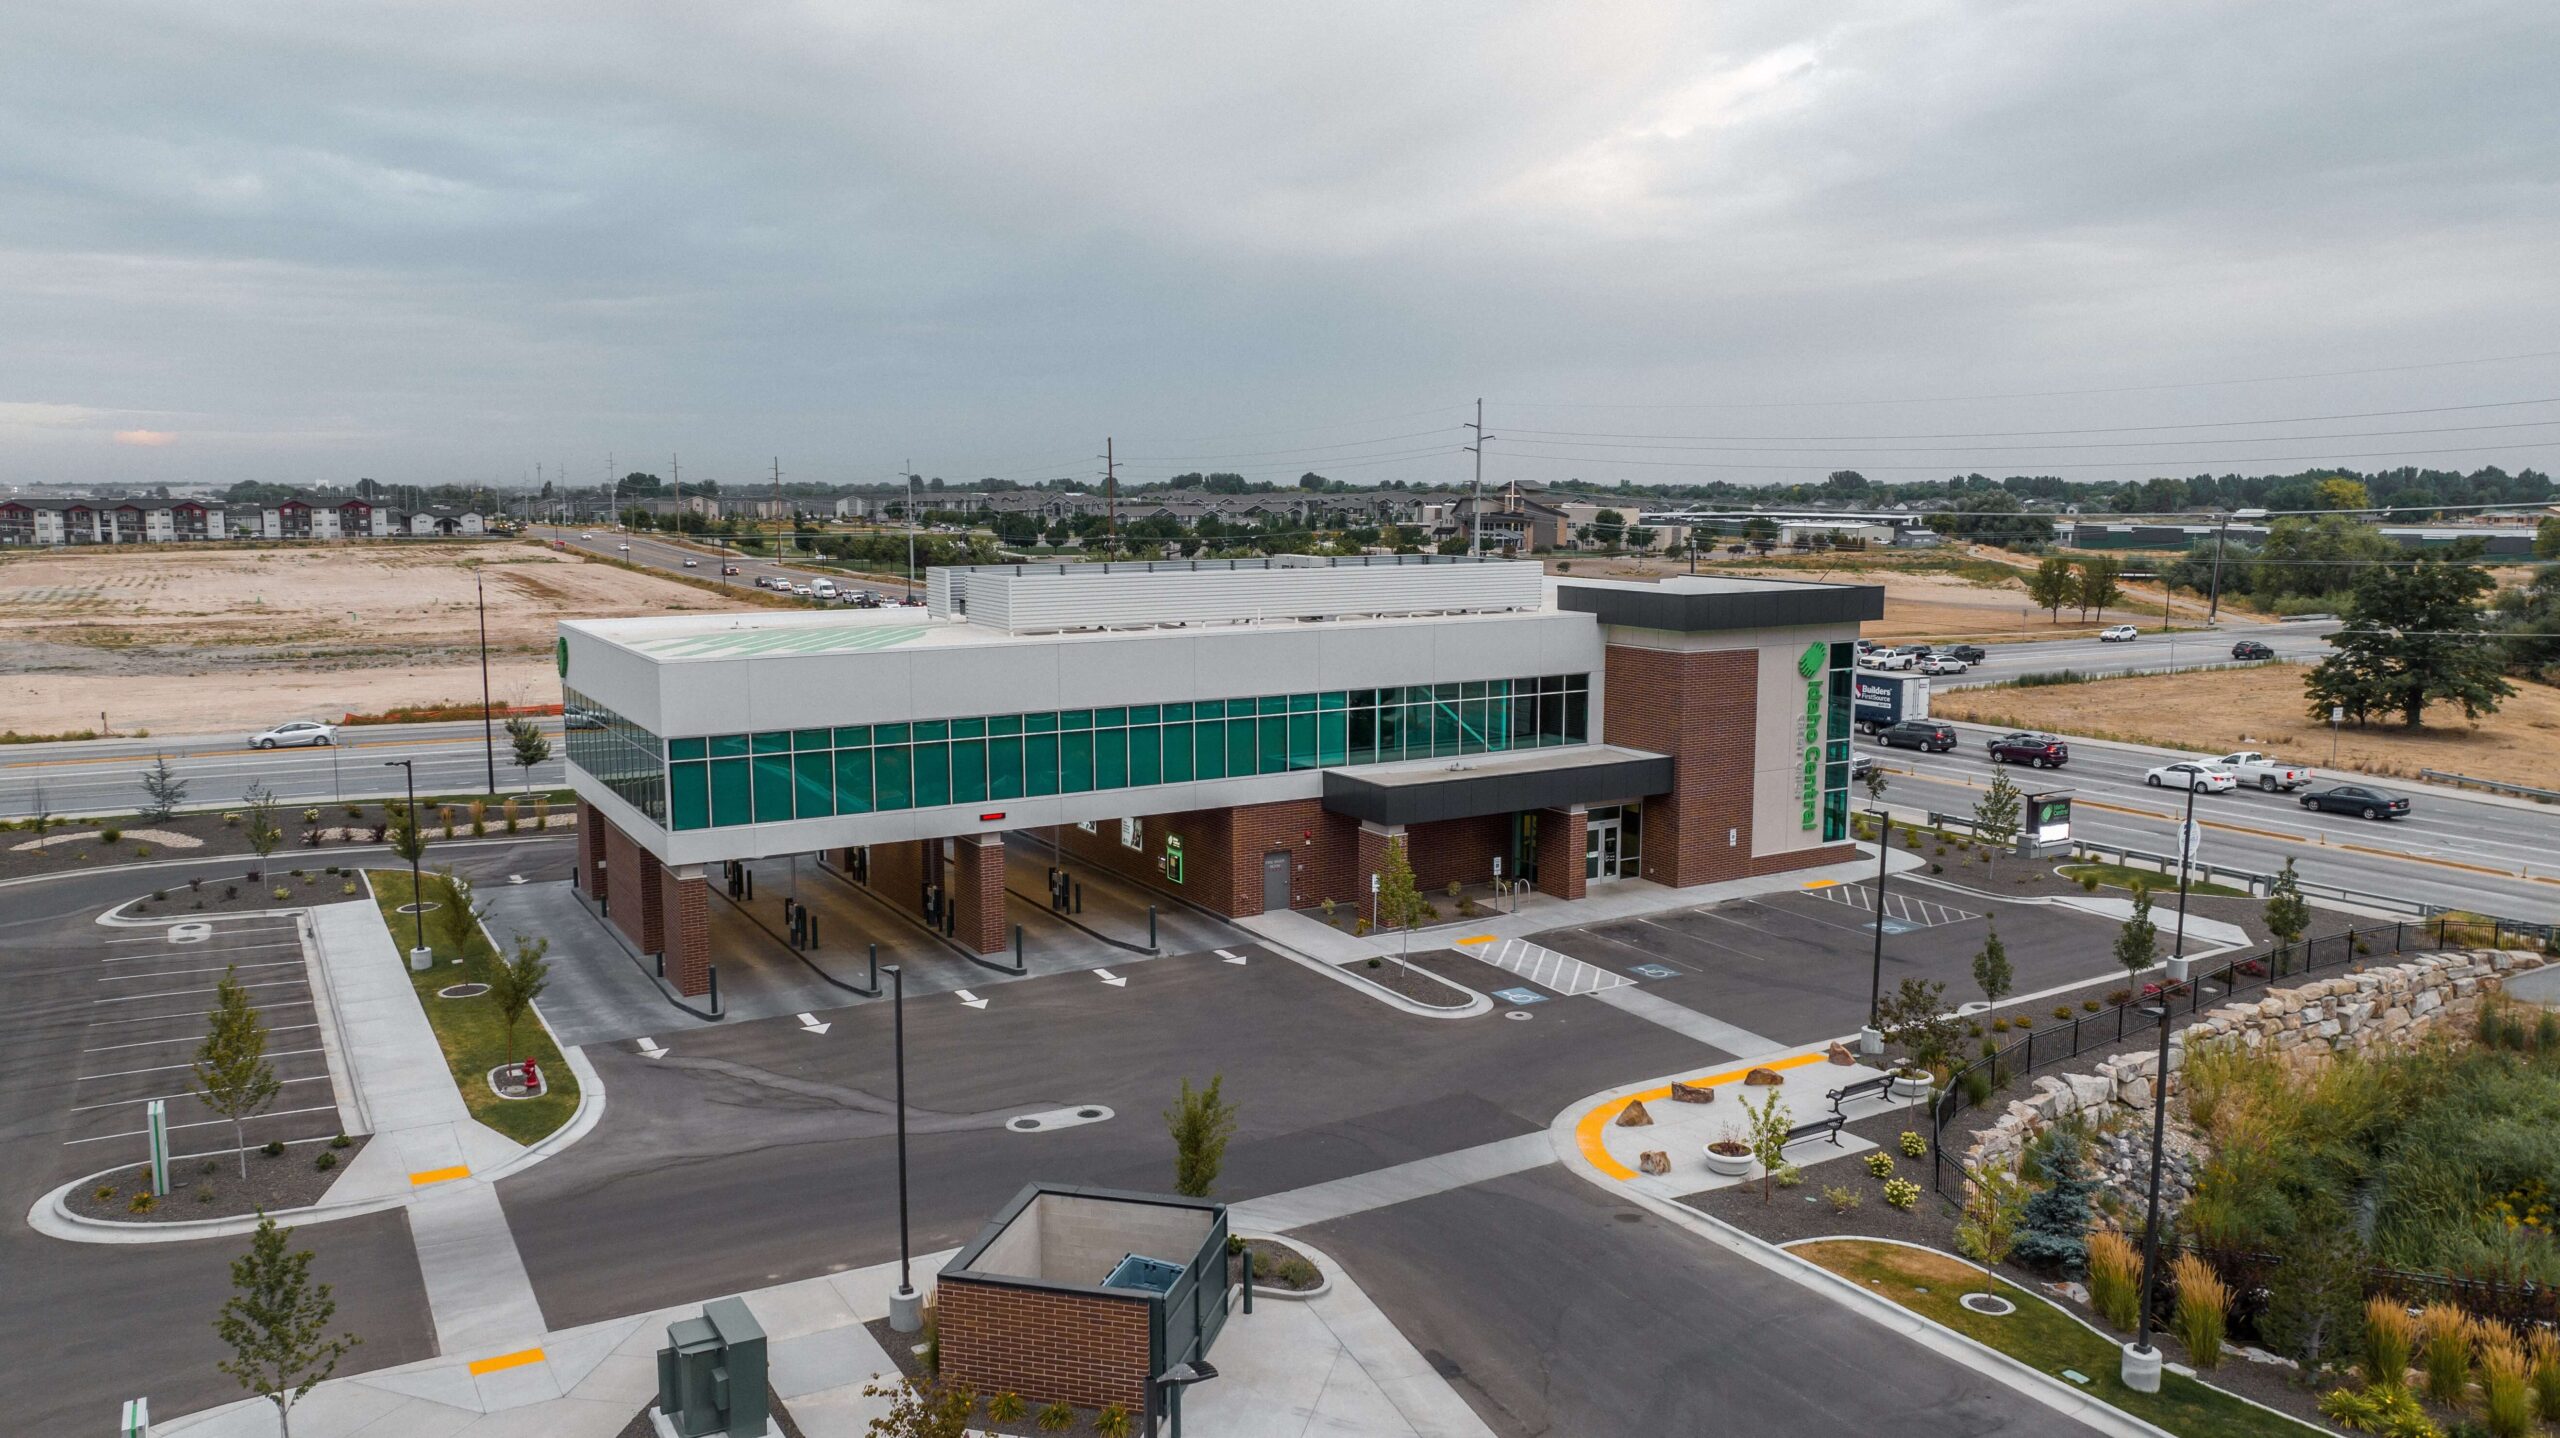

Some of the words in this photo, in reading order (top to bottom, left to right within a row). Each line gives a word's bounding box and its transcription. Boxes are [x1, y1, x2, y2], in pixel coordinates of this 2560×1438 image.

[1861, 692, 1891, 702] FirstSource
[1862, 685, 1891, 696] Builders
[1806, 680, 1824, 744] Idaho
[1802, 746, 1821, 831] Central
